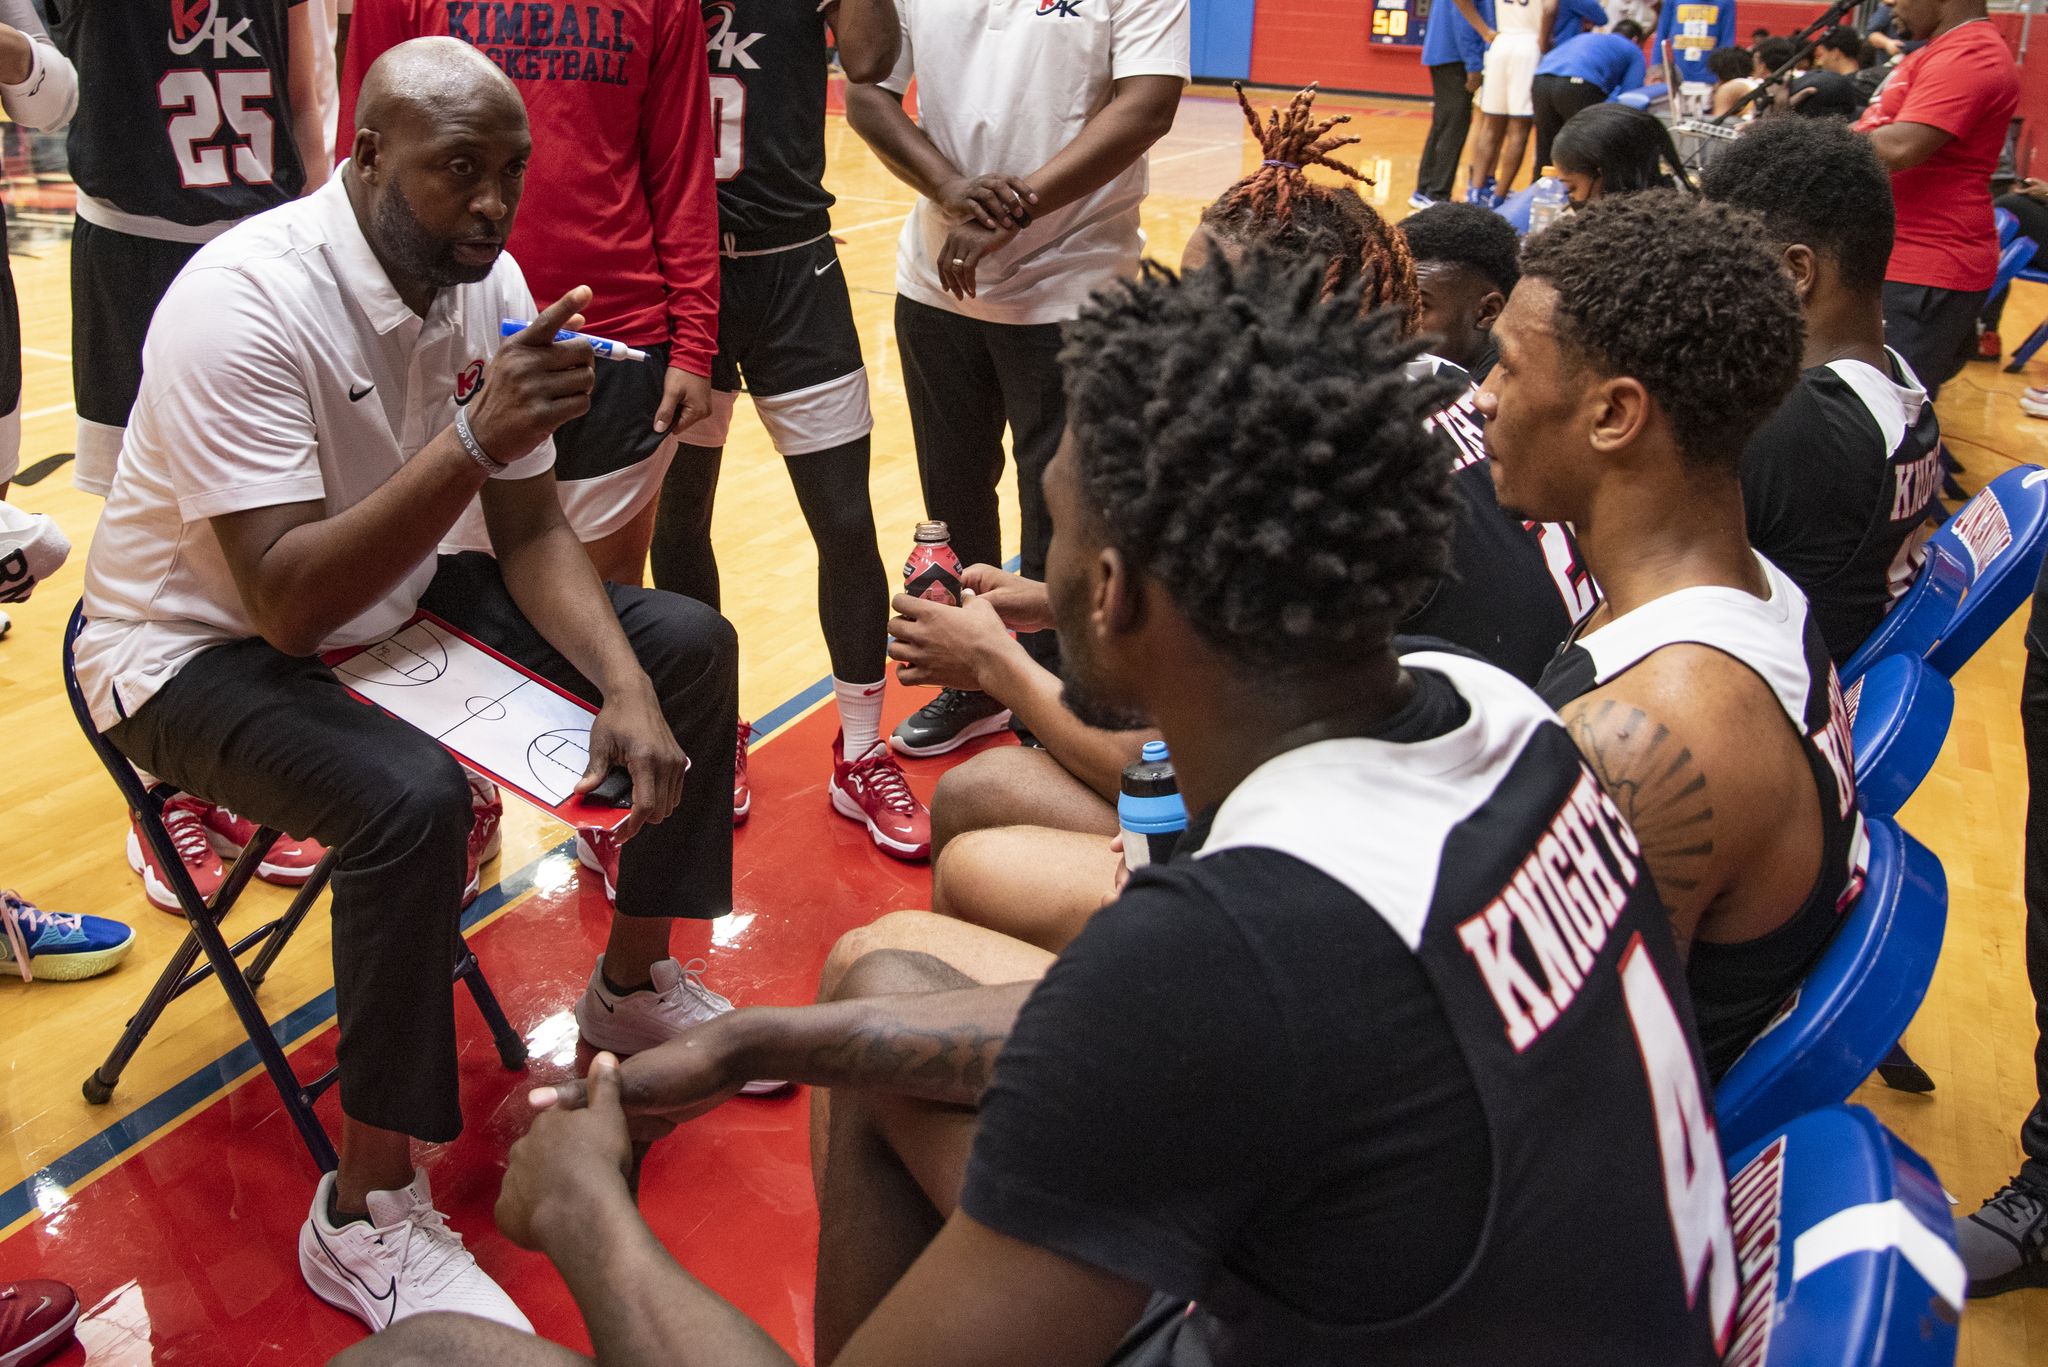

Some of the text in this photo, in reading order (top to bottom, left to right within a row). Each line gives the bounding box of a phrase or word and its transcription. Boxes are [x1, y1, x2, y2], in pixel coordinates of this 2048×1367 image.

[446, 1, 634, 53] KIMBALL
[1372, 10, 1408, 36] 50
[485, 47, 629, 86] SKETBALL
[156, 68, 275, 189] 25
[1456, 760, 1641, 1054] KNIGHTS
